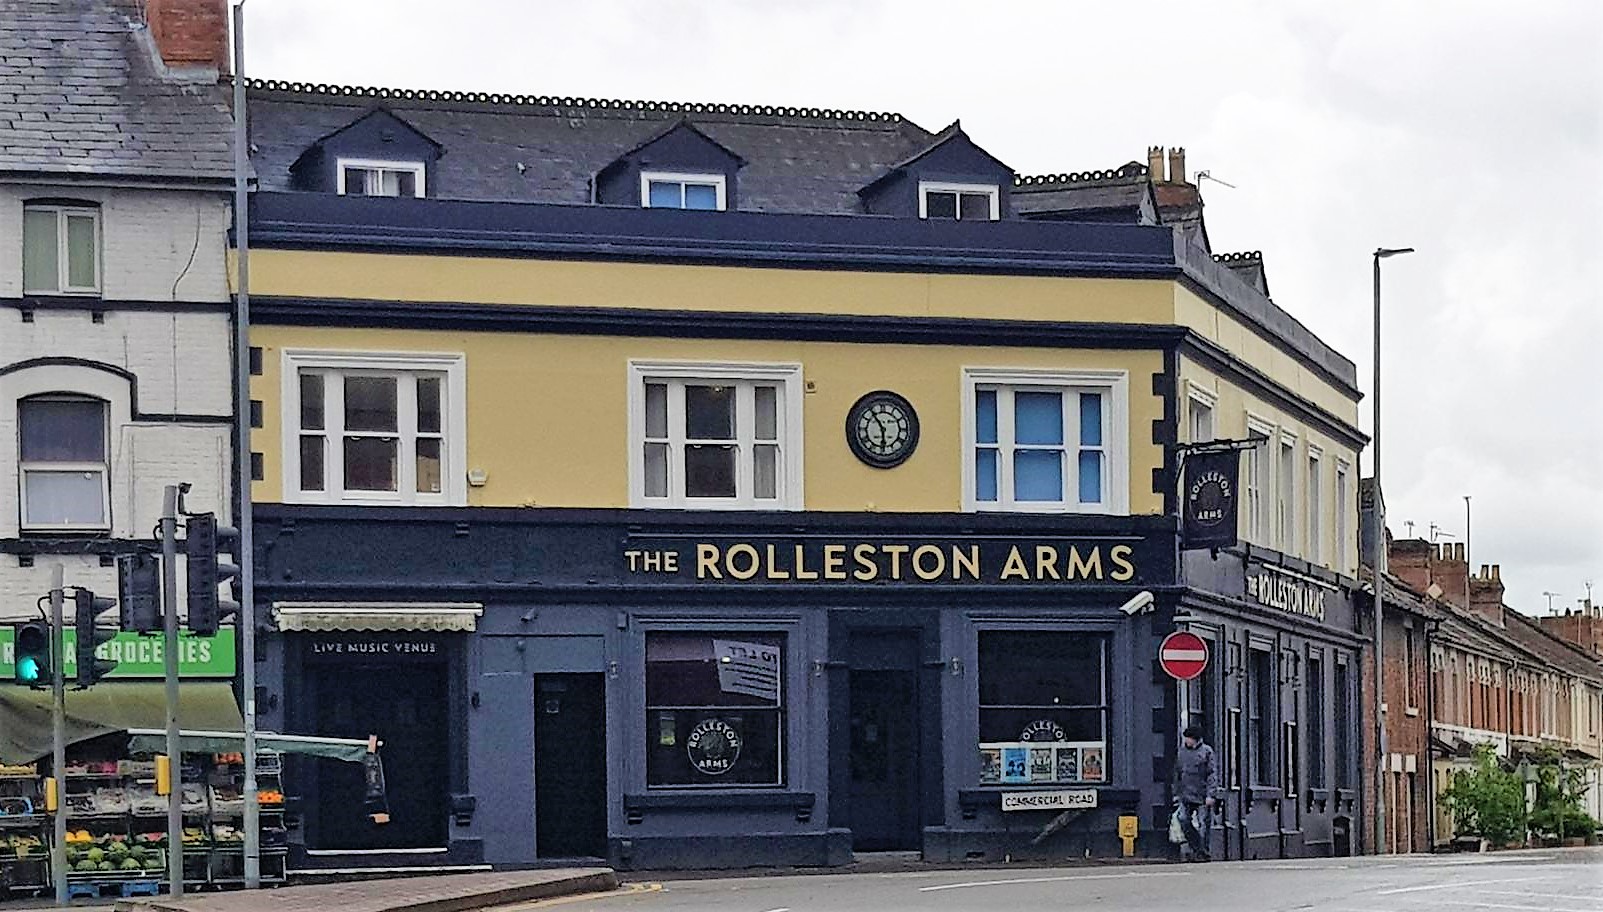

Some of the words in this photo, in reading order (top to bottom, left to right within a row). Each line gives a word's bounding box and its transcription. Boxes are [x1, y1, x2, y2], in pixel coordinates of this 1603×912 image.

[1190, 472, 1231, 500] ROLLESTON
[1198, 509, 1222, 519] ARMS
[624, 551, 679, 572] THE
[696, 543, 980, 581] ROLLESTON
[1000, 545, 1134, 581] ARMS
[1258, 574, 1303, 613] ROLLESTON
[1303, 587, 1325, 621] ARMS
[94, 640, 212, 664] GROCEIES
[313, 643, 342, 653] LIVE
[348, 643, 389, 653] MUSIC
[395, 643, 436, 653] VENUE
[689, 721, 739, 747] ROLLESTON
[1020, 720, 1067, 742] OLLESTO
[699, 759, 728, 768] ARMS
[1005, 795, 1064, 807] COMMERCIAL
[1068, 794, 1094, 804] ROAD
